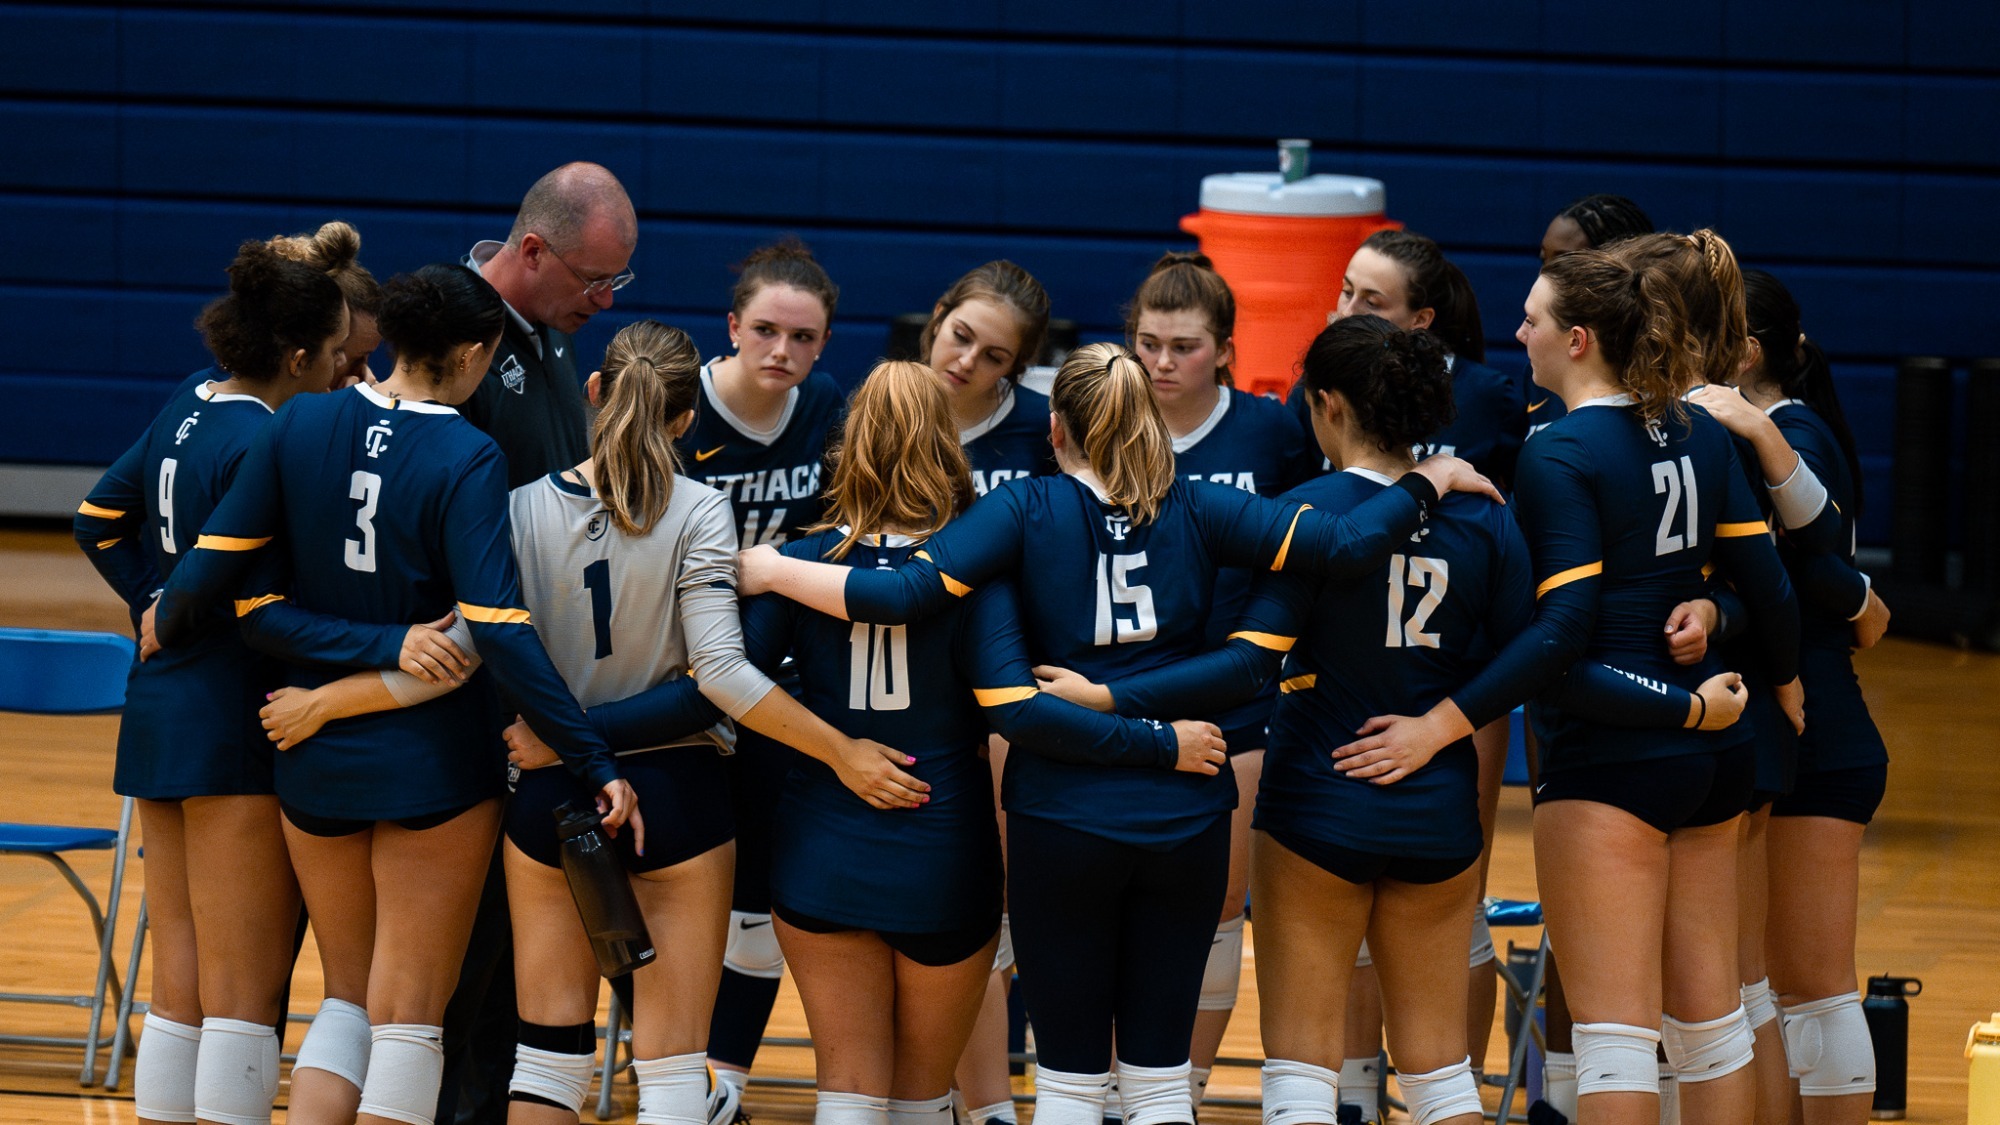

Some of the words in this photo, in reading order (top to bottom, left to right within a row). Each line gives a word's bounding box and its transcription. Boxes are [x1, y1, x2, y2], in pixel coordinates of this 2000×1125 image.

[158, 457, 177, 554] 9
[344, 470, 382, 573] 3
[1651, 455, 1698, 556] 21
[583, 558, 613, 660] 1
[1094, 550, 1158, 646] 15
[1385, 553, 1448, 649] 12
[849, 621, 911, 711] 10
